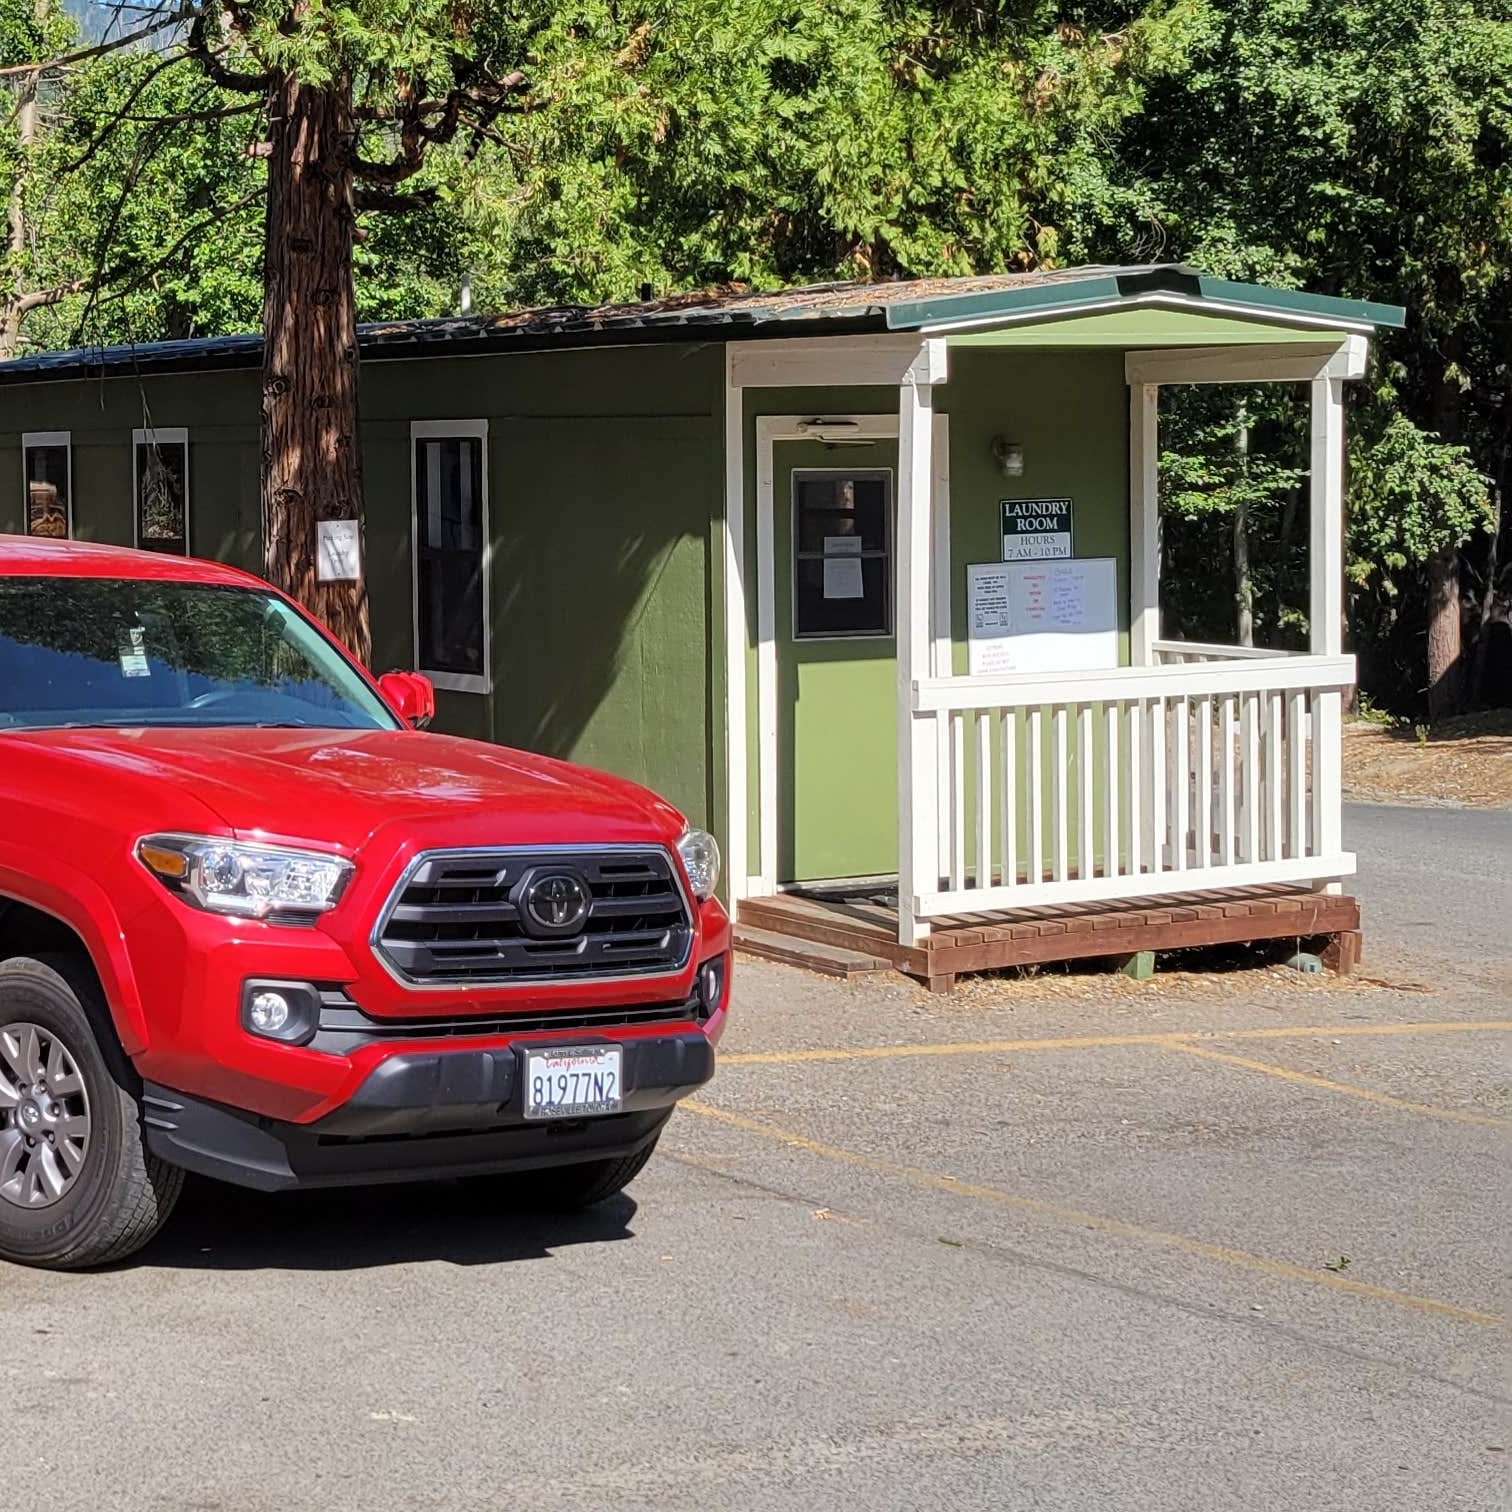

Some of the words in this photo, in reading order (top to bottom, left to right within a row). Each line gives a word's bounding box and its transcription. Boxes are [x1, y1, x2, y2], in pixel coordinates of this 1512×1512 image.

[1005, 501, 1069, 517] LAUNDRY
[1016, 517, 1059, 531] ROOM
[1020, 535, 1056, 546] HOURS
[1007, 548, 1014, 559] 7
[1016, 547, 1032, 558] AM
[1052, 546, 1067, 557] PM
[533, 1071, 616, 1106] 81977N2
